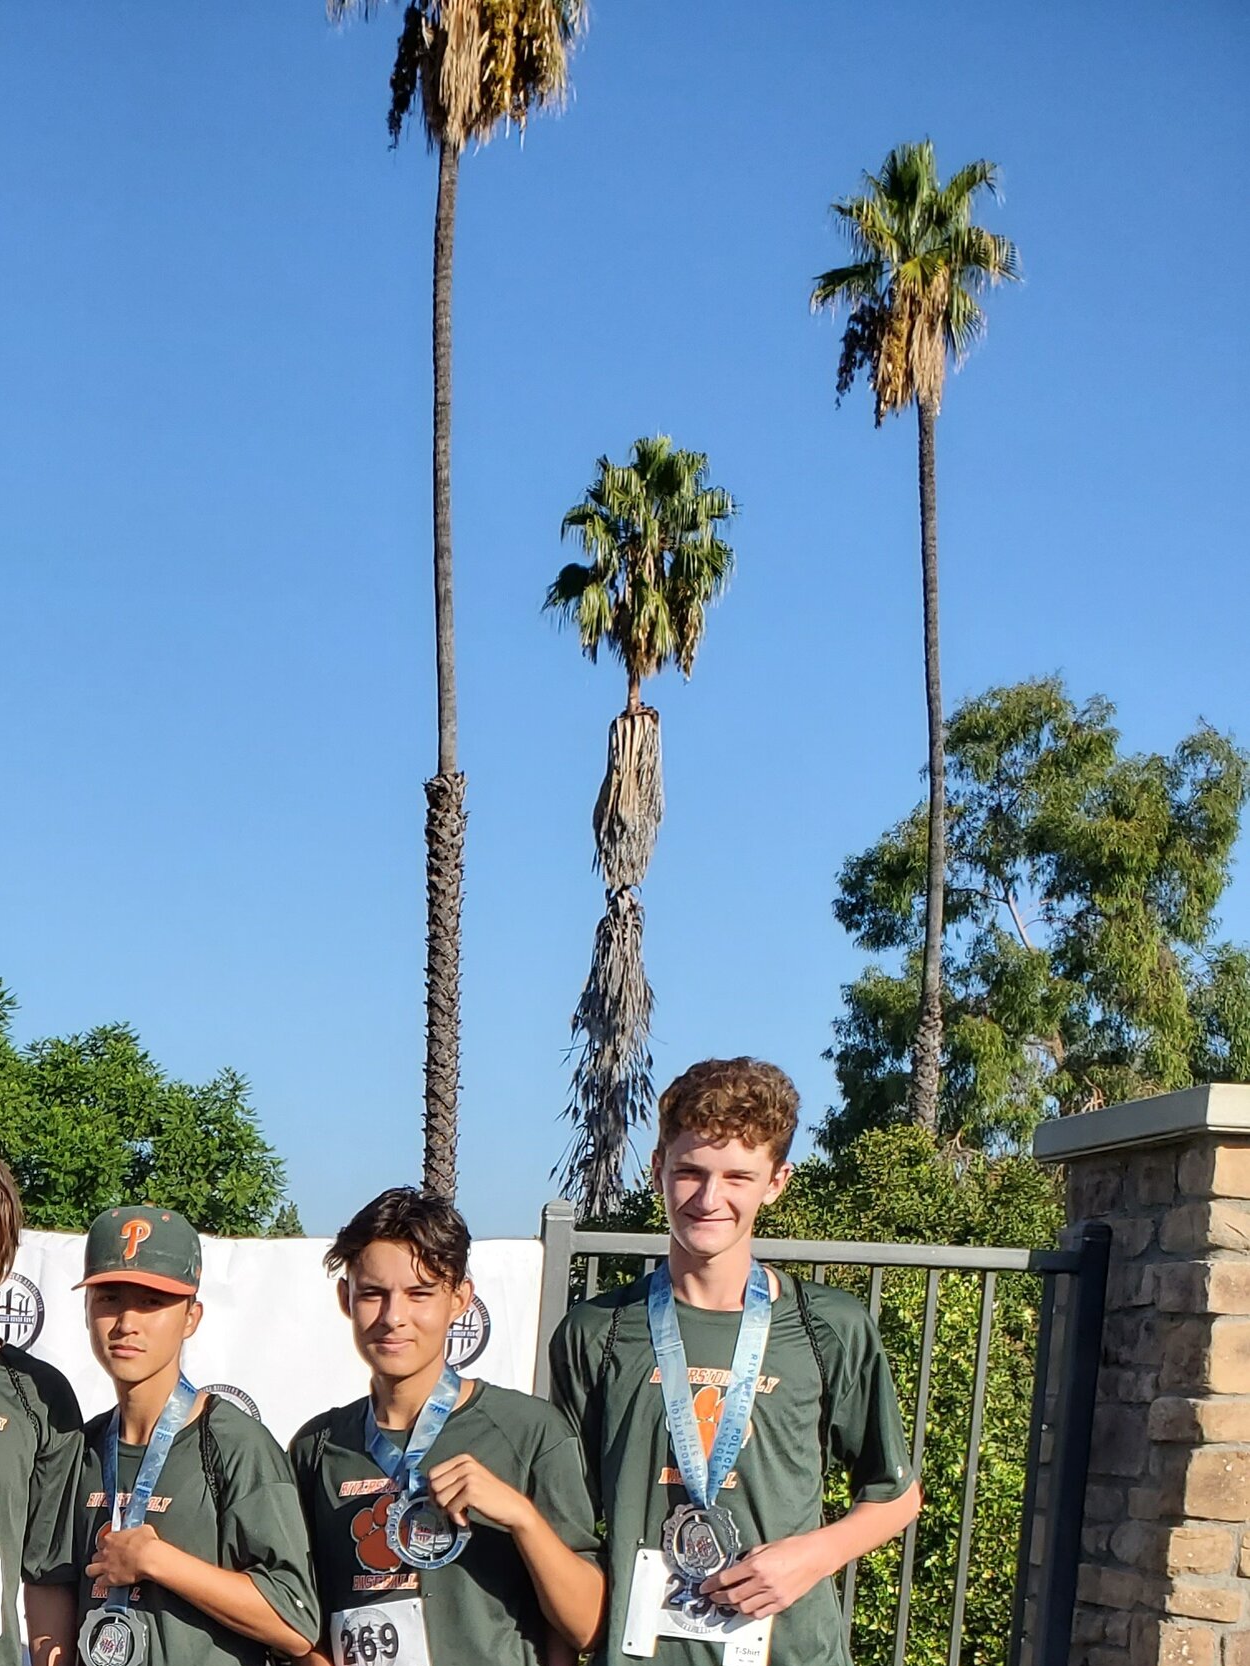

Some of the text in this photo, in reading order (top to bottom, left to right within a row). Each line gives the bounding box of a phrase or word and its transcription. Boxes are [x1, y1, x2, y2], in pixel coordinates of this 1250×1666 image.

[120, 1219, 151, 1260] P
[352, 1573, 418, 1590] BASEBALL
[340, 1622, 399, 1666] 269
[735, 1646, 761, 1657] T-Shirt
